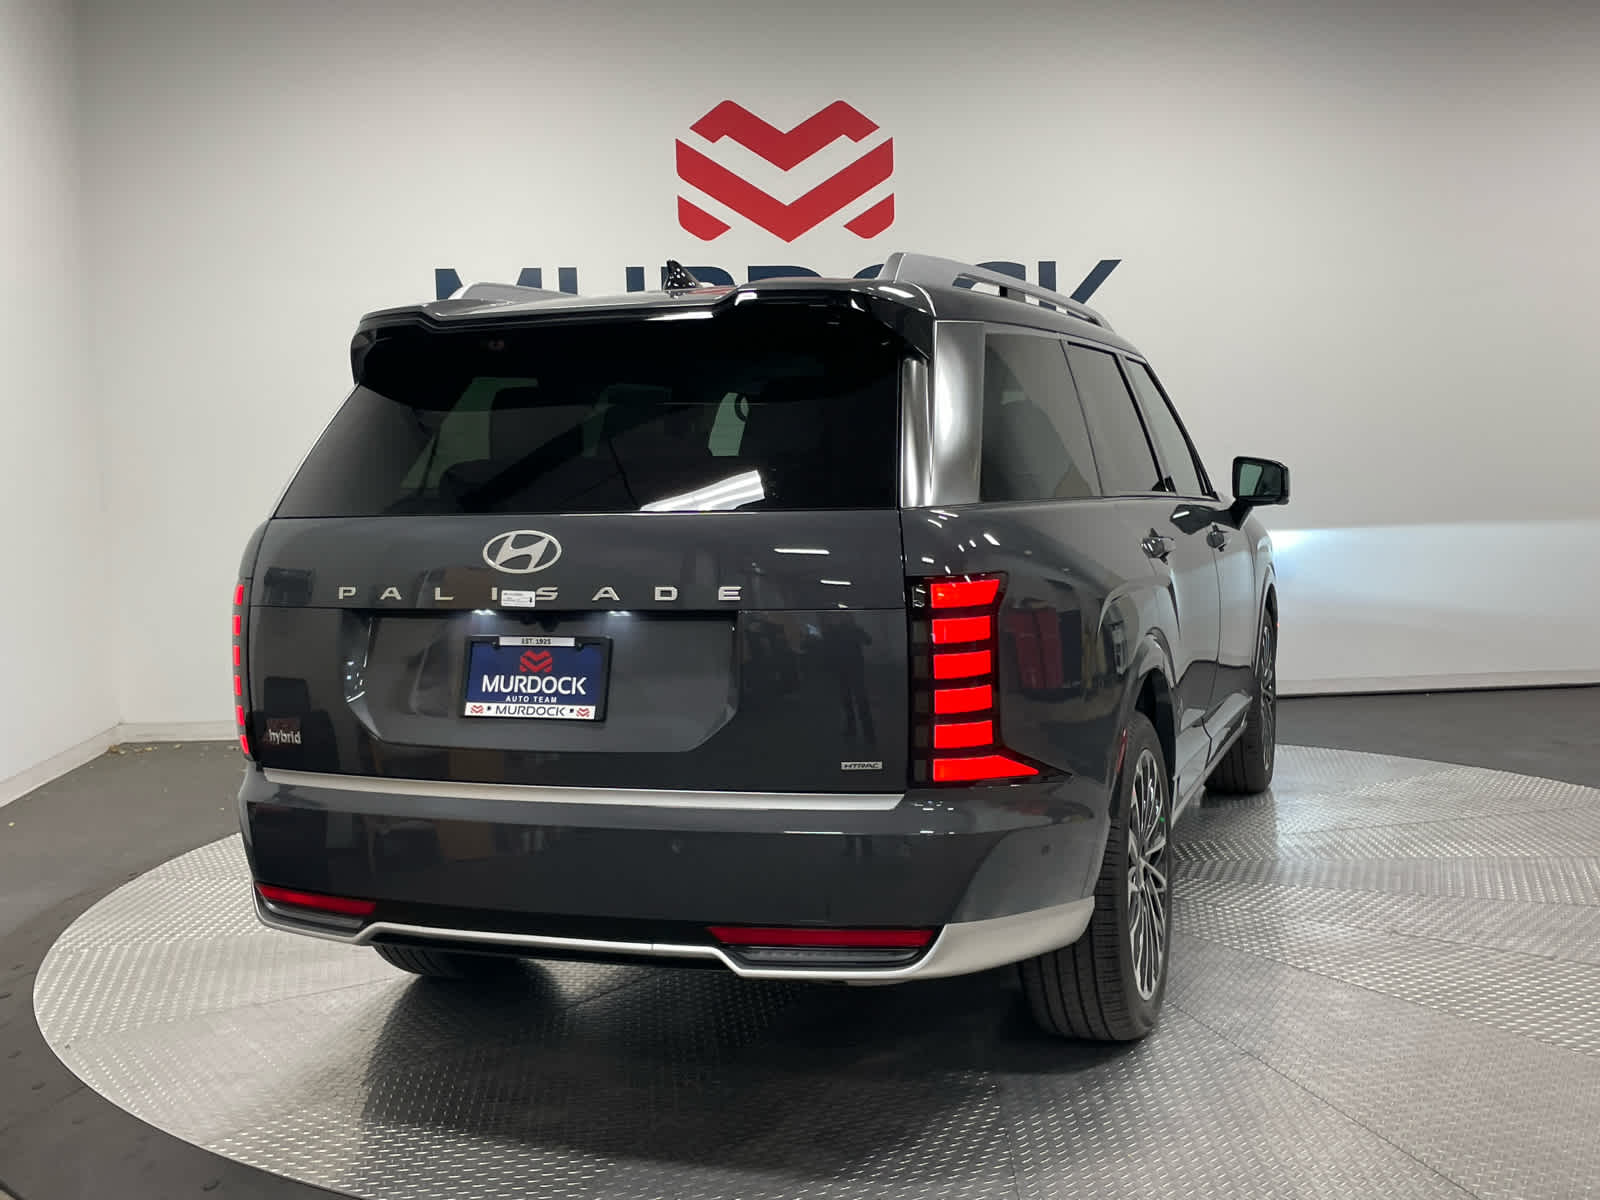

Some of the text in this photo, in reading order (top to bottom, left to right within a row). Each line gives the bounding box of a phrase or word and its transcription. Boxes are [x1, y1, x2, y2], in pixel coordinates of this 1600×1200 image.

[338, 586, 742, 602] PALISADE
[482, 674, 587, 695] MURDOCK
[505, 695, 557, 704] AUTO TEAM
[495, 705, 566, 717] MURDOCK
[268, 728, 302, 745] hybrid
